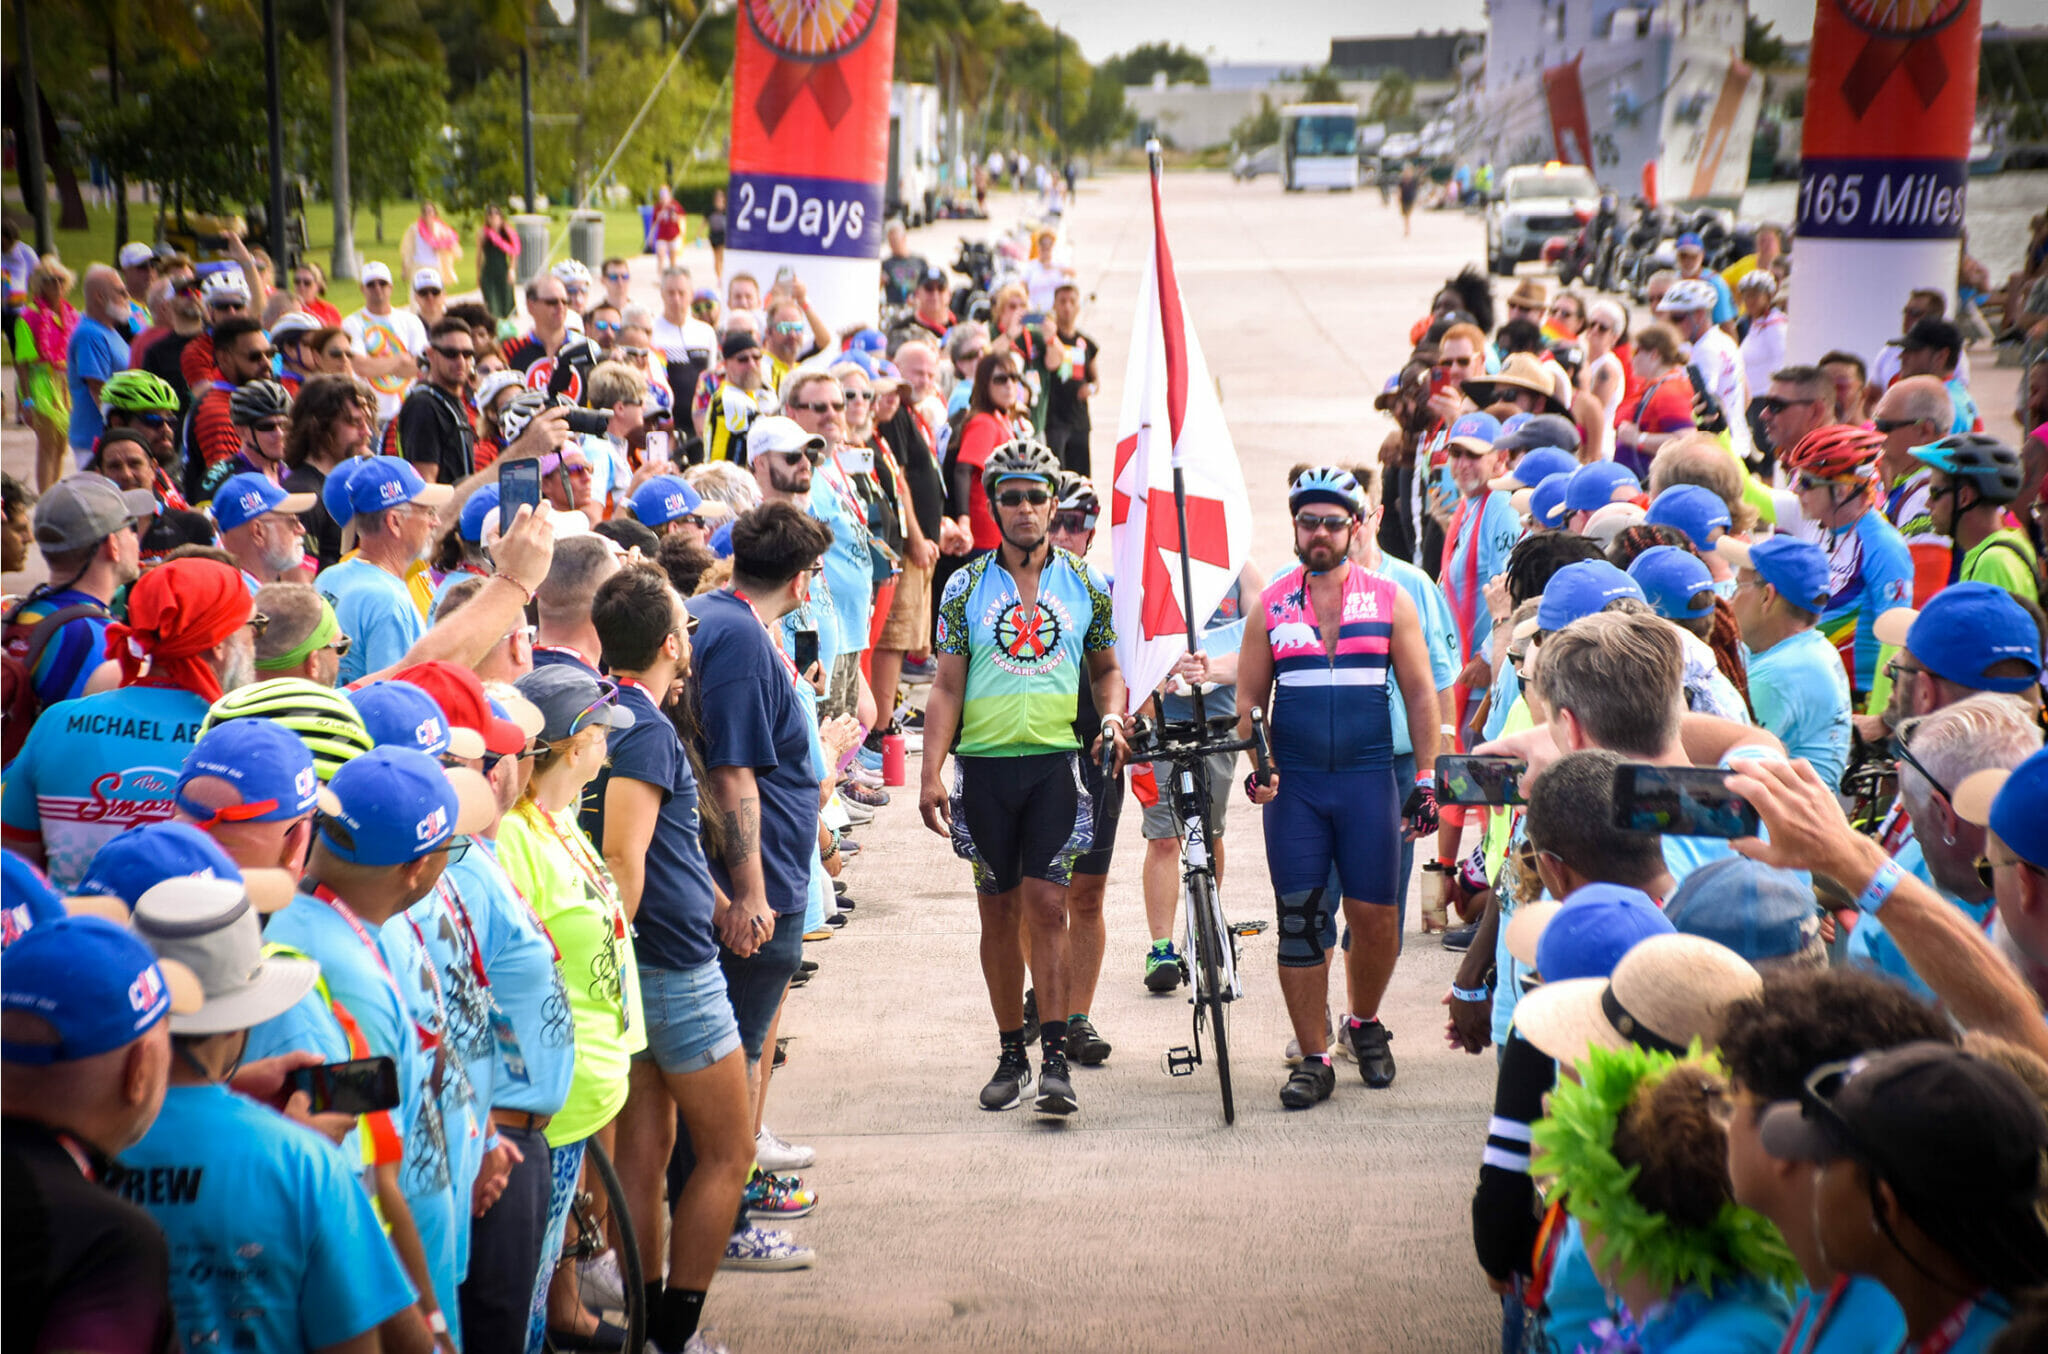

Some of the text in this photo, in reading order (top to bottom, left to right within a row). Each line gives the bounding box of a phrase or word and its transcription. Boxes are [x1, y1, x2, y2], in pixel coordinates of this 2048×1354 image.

[736, 182, 866, 249] 2-Days
[1801, 173, 1966, 226] 165 Miles
[983, 591, 1011, 626] GIVE
[66, 715, 164, 742] MICHAEL
[131, 774, 168, 792] The
